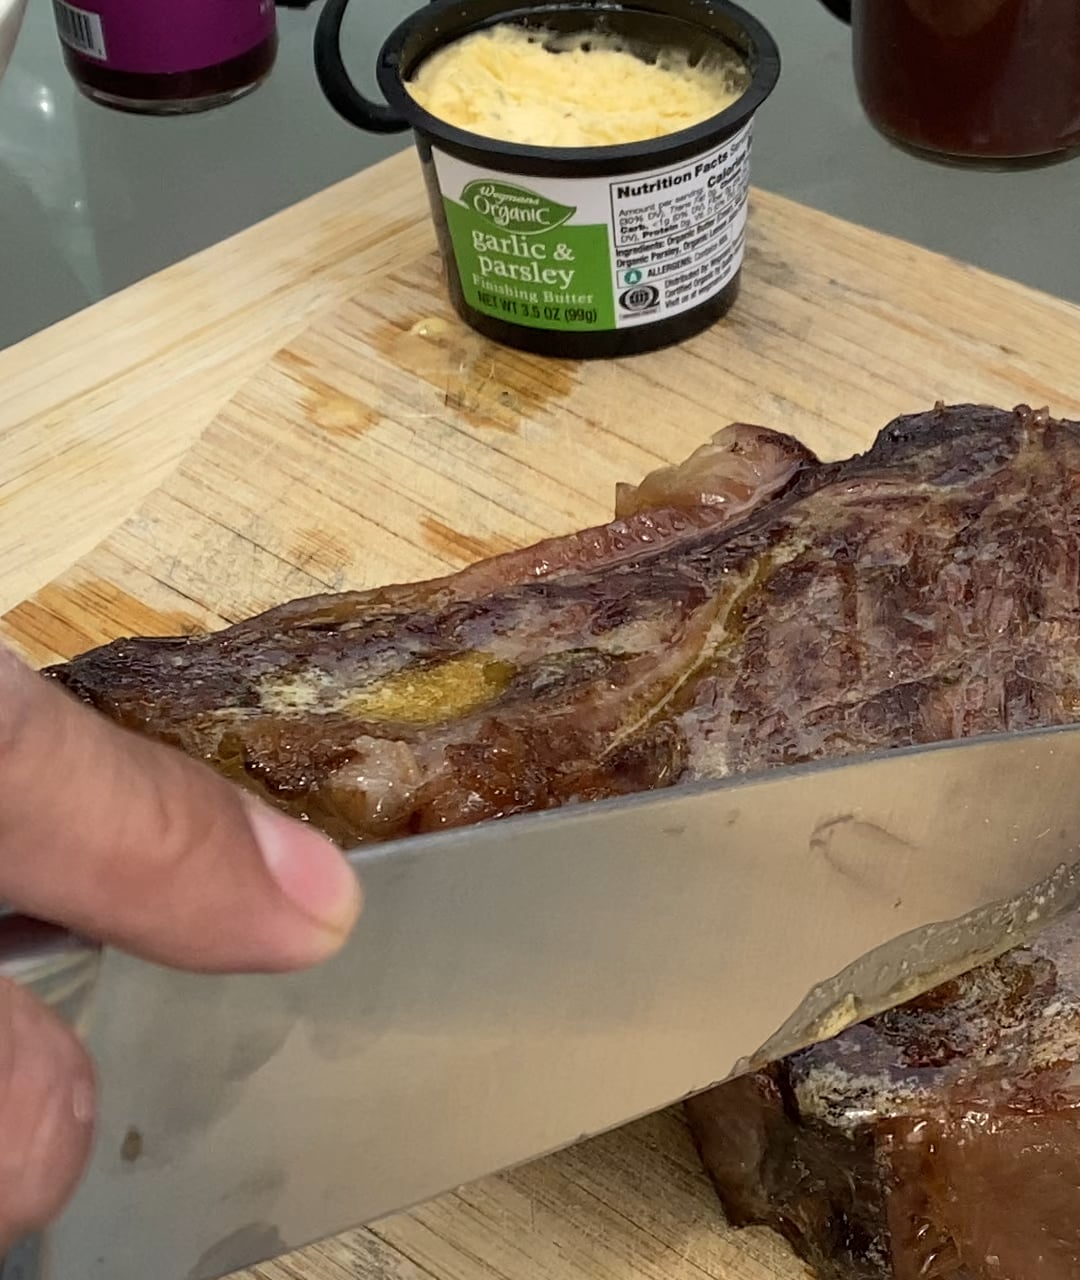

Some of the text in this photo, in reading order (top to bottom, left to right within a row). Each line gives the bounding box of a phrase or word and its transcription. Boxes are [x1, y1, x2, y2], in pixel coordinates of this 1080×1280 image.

[617, 172, 692, 199] Nutrition
[694, 151, 728, 178] Facts
[619, 203, 655, 218] Amount
[659, 200, 672, 211] per
[620, 222, 648, 235] Carb.
[642, 223, 678, 239] Protein
[472, 230, 575, 261] garlic &
[478, 255, 575, 290] parsley
[616, 255, 648, 268] Organic
[472, 273, 538, 303] Finishing
[543, 291, 593, 304] Butter
[478, 291, 597, 323] NET WT 3.5 OZ (99g)
